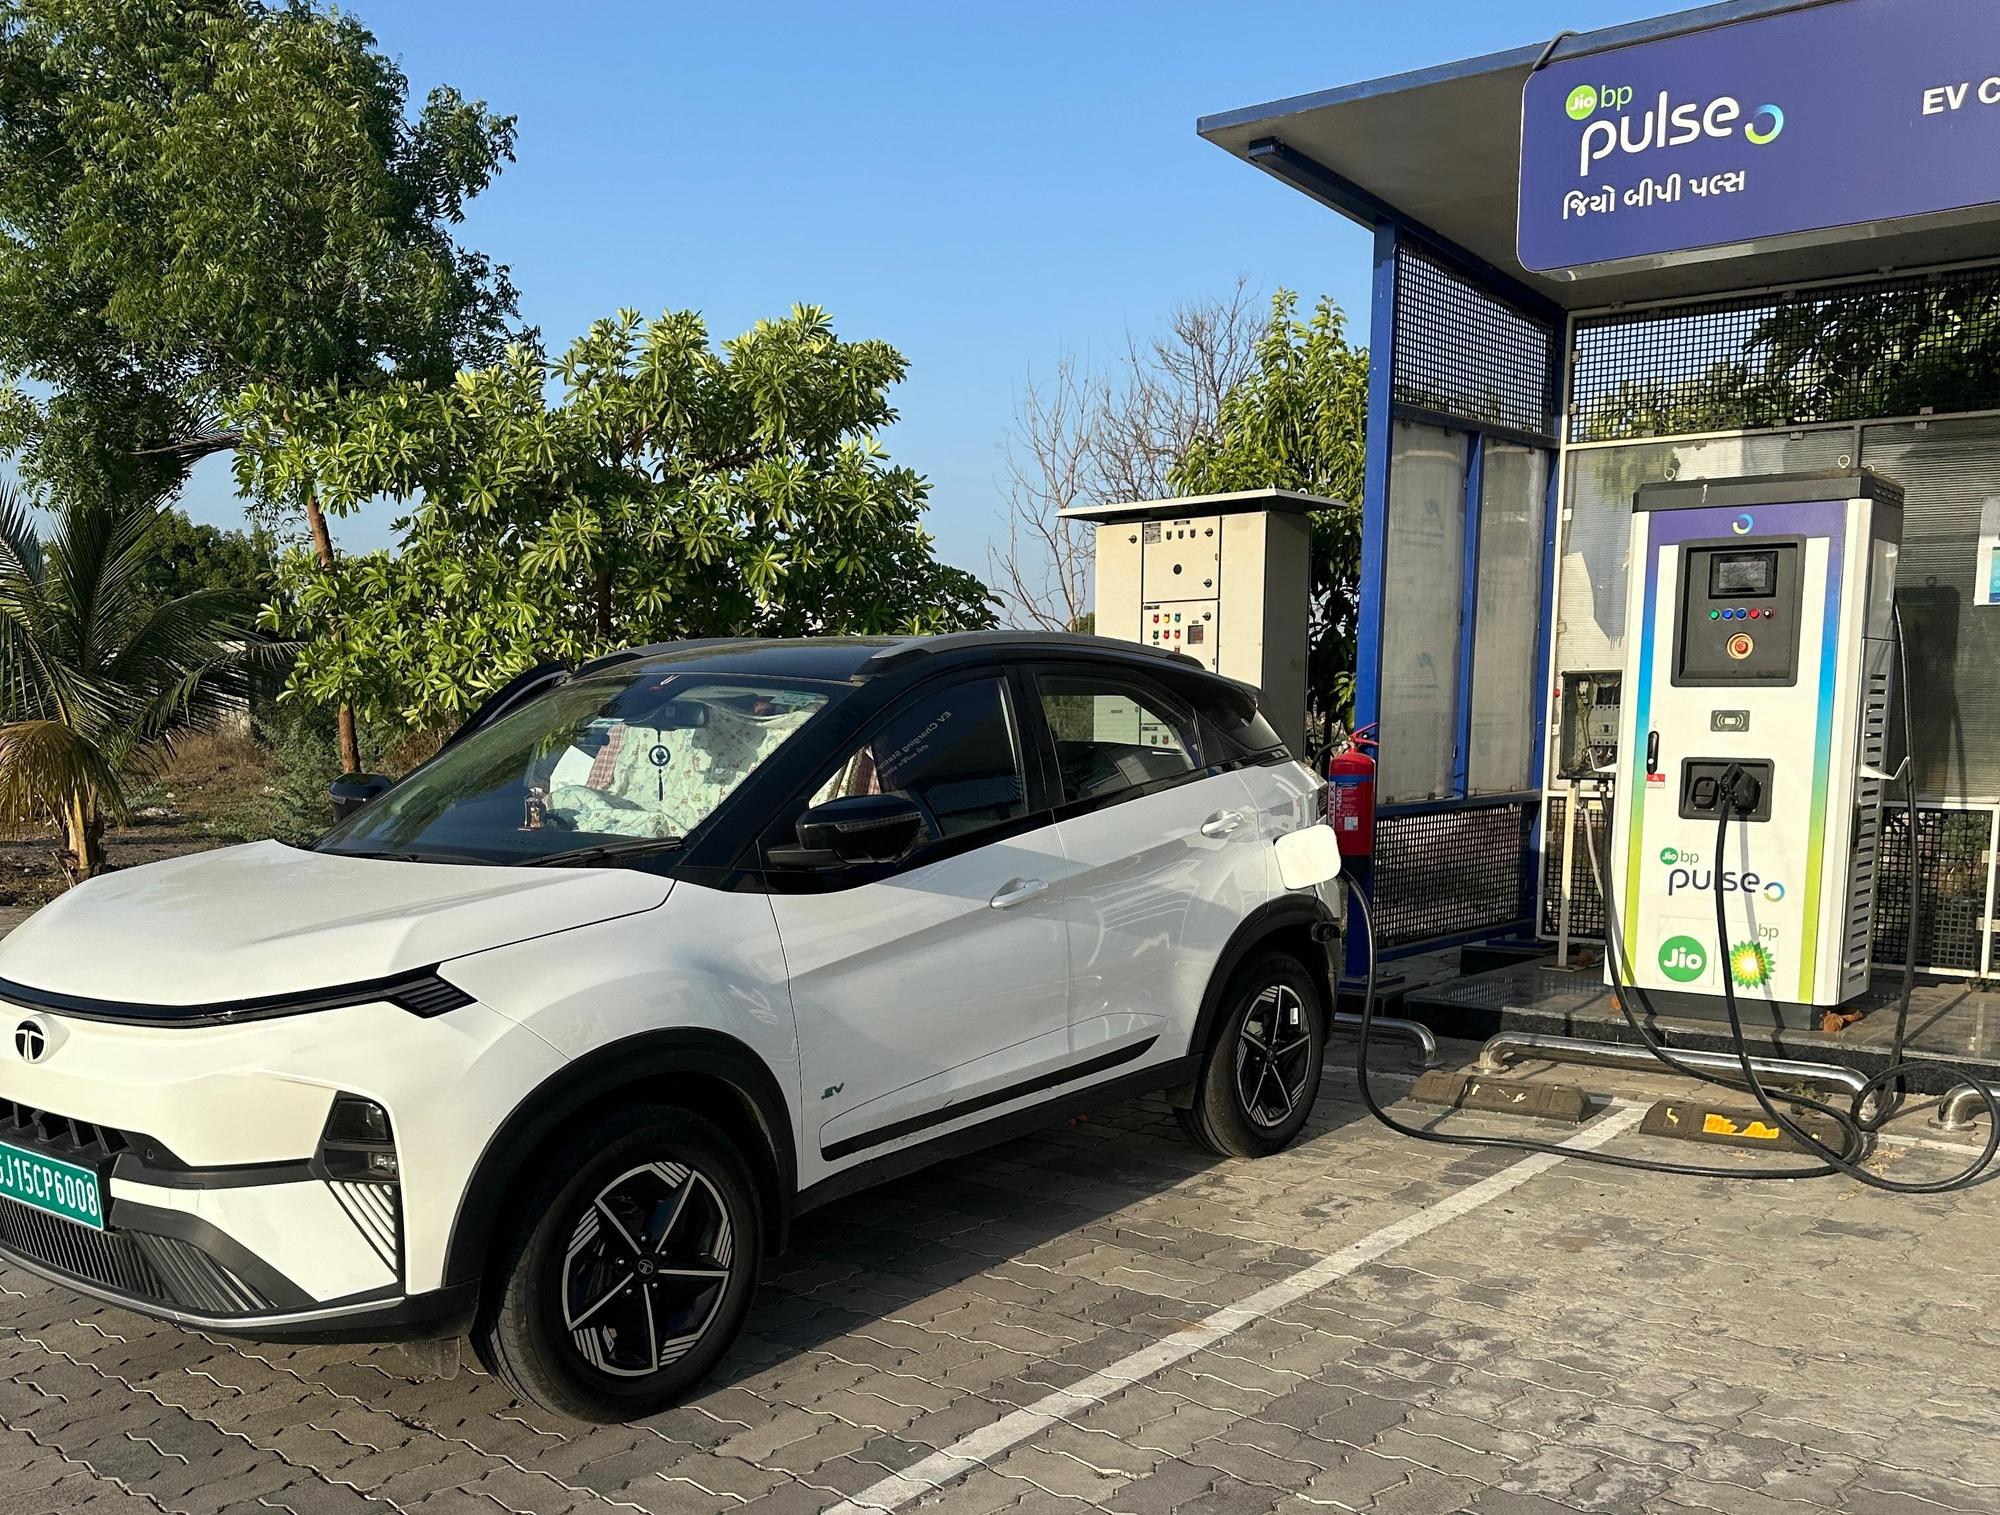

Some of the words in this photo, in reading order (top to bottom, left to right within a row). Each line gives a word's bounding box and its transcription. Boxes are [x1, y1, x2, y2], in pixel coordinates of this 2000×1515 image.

[1569, 93, 1595, 112] Jio
[1601, 85, 1633, 111] bp
[1922, 82, 1968, 115] EV
[1580, 91, 1740, 177] pulse
[1563, 185, 1616, 220] જિયો
[1624, 174, 1682, 207] બીપી
[1689, 171, 1745, 197] પલ્સ
[1680, 850, 1699, 866] bp
[1668, 868, 1760, 896] puse
[1758, 923, 1779, 941] bp
[1663, 947, 1703, 970] Jio
